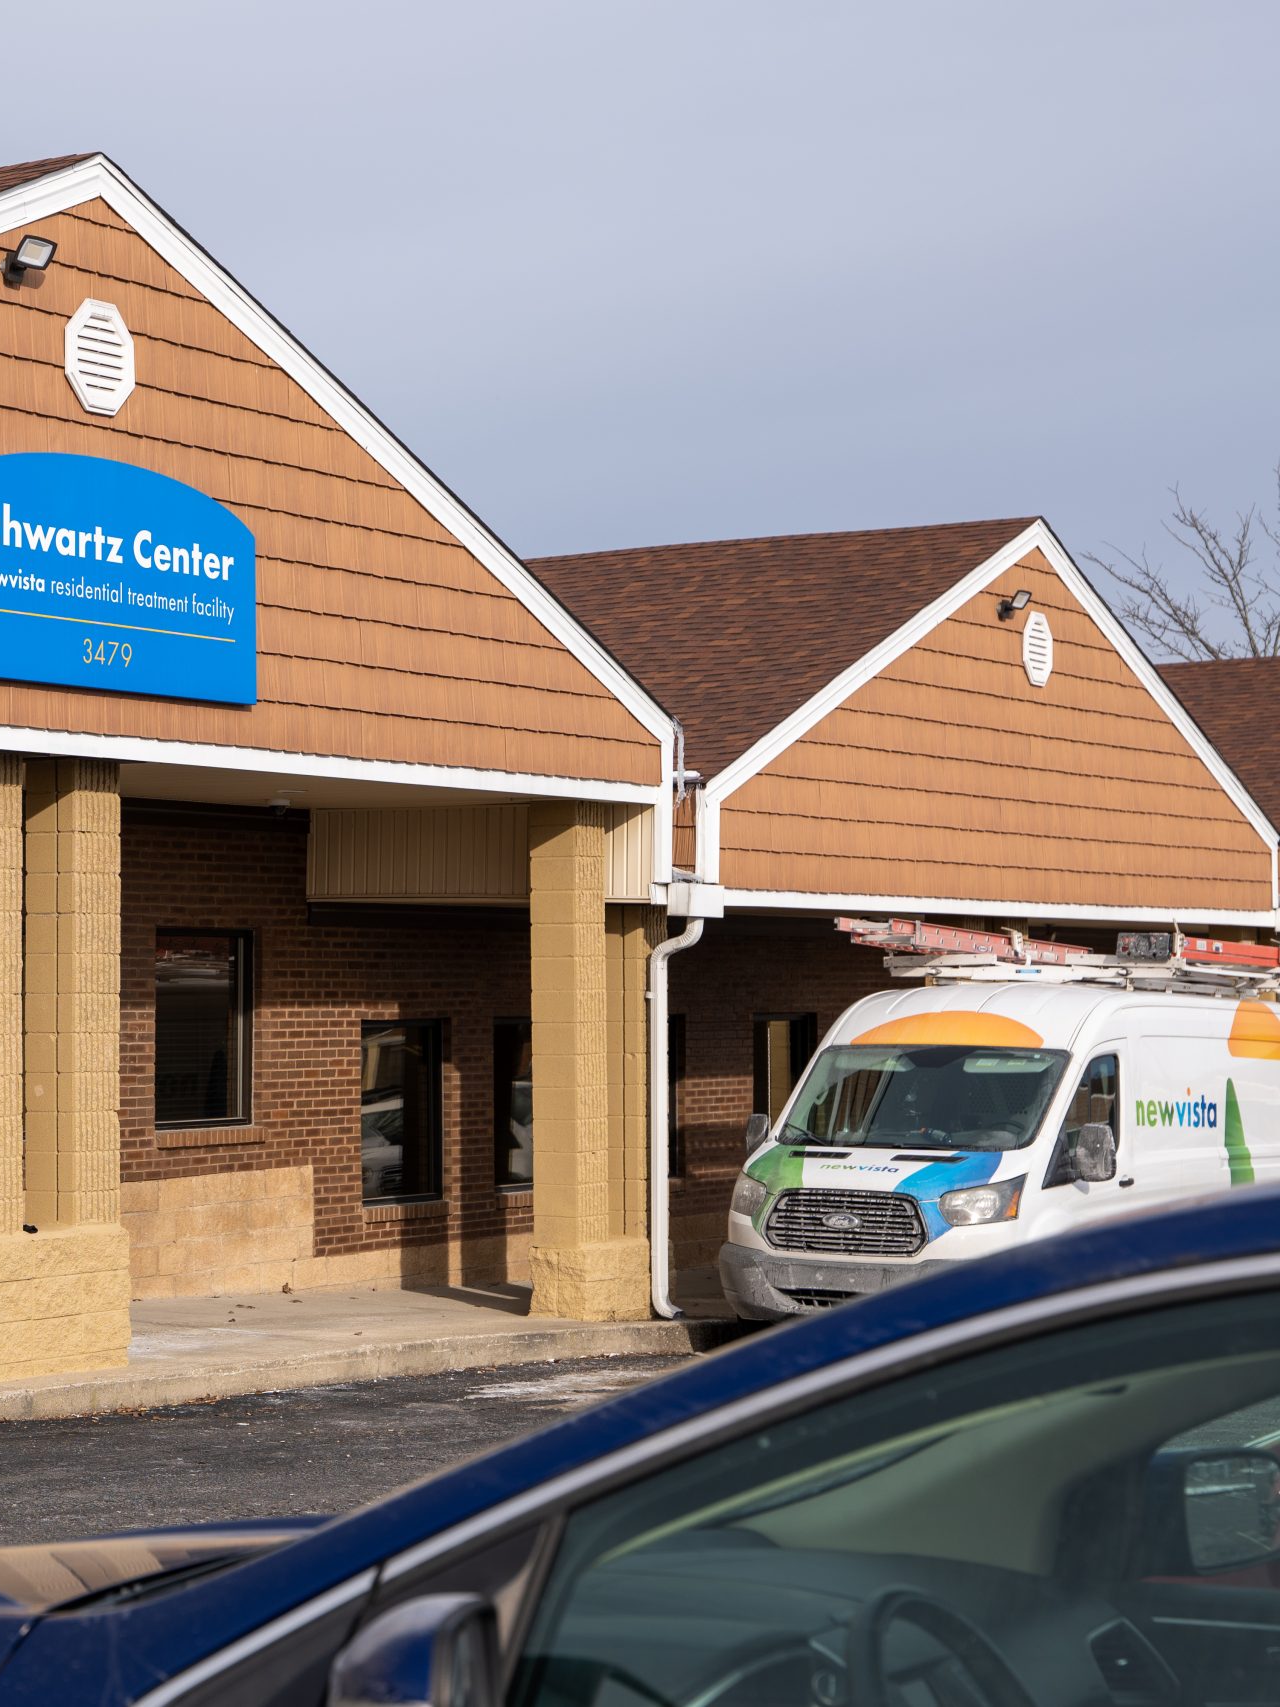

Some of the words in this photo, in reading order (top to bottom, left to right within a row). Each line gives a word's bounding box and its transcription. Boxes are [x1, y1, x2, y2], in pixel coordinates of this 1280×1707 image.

[133, 529, 235, 581] Center
[51, 576, 123, 604] residential
[127, 590, 188, 613] treatment
[192, 592, 235, 625] facility
[82, 638, 133, 668] 3479
[1135, 1086, 1218, 1129] newvista
[819, 1163, 900, 1173] newvista
